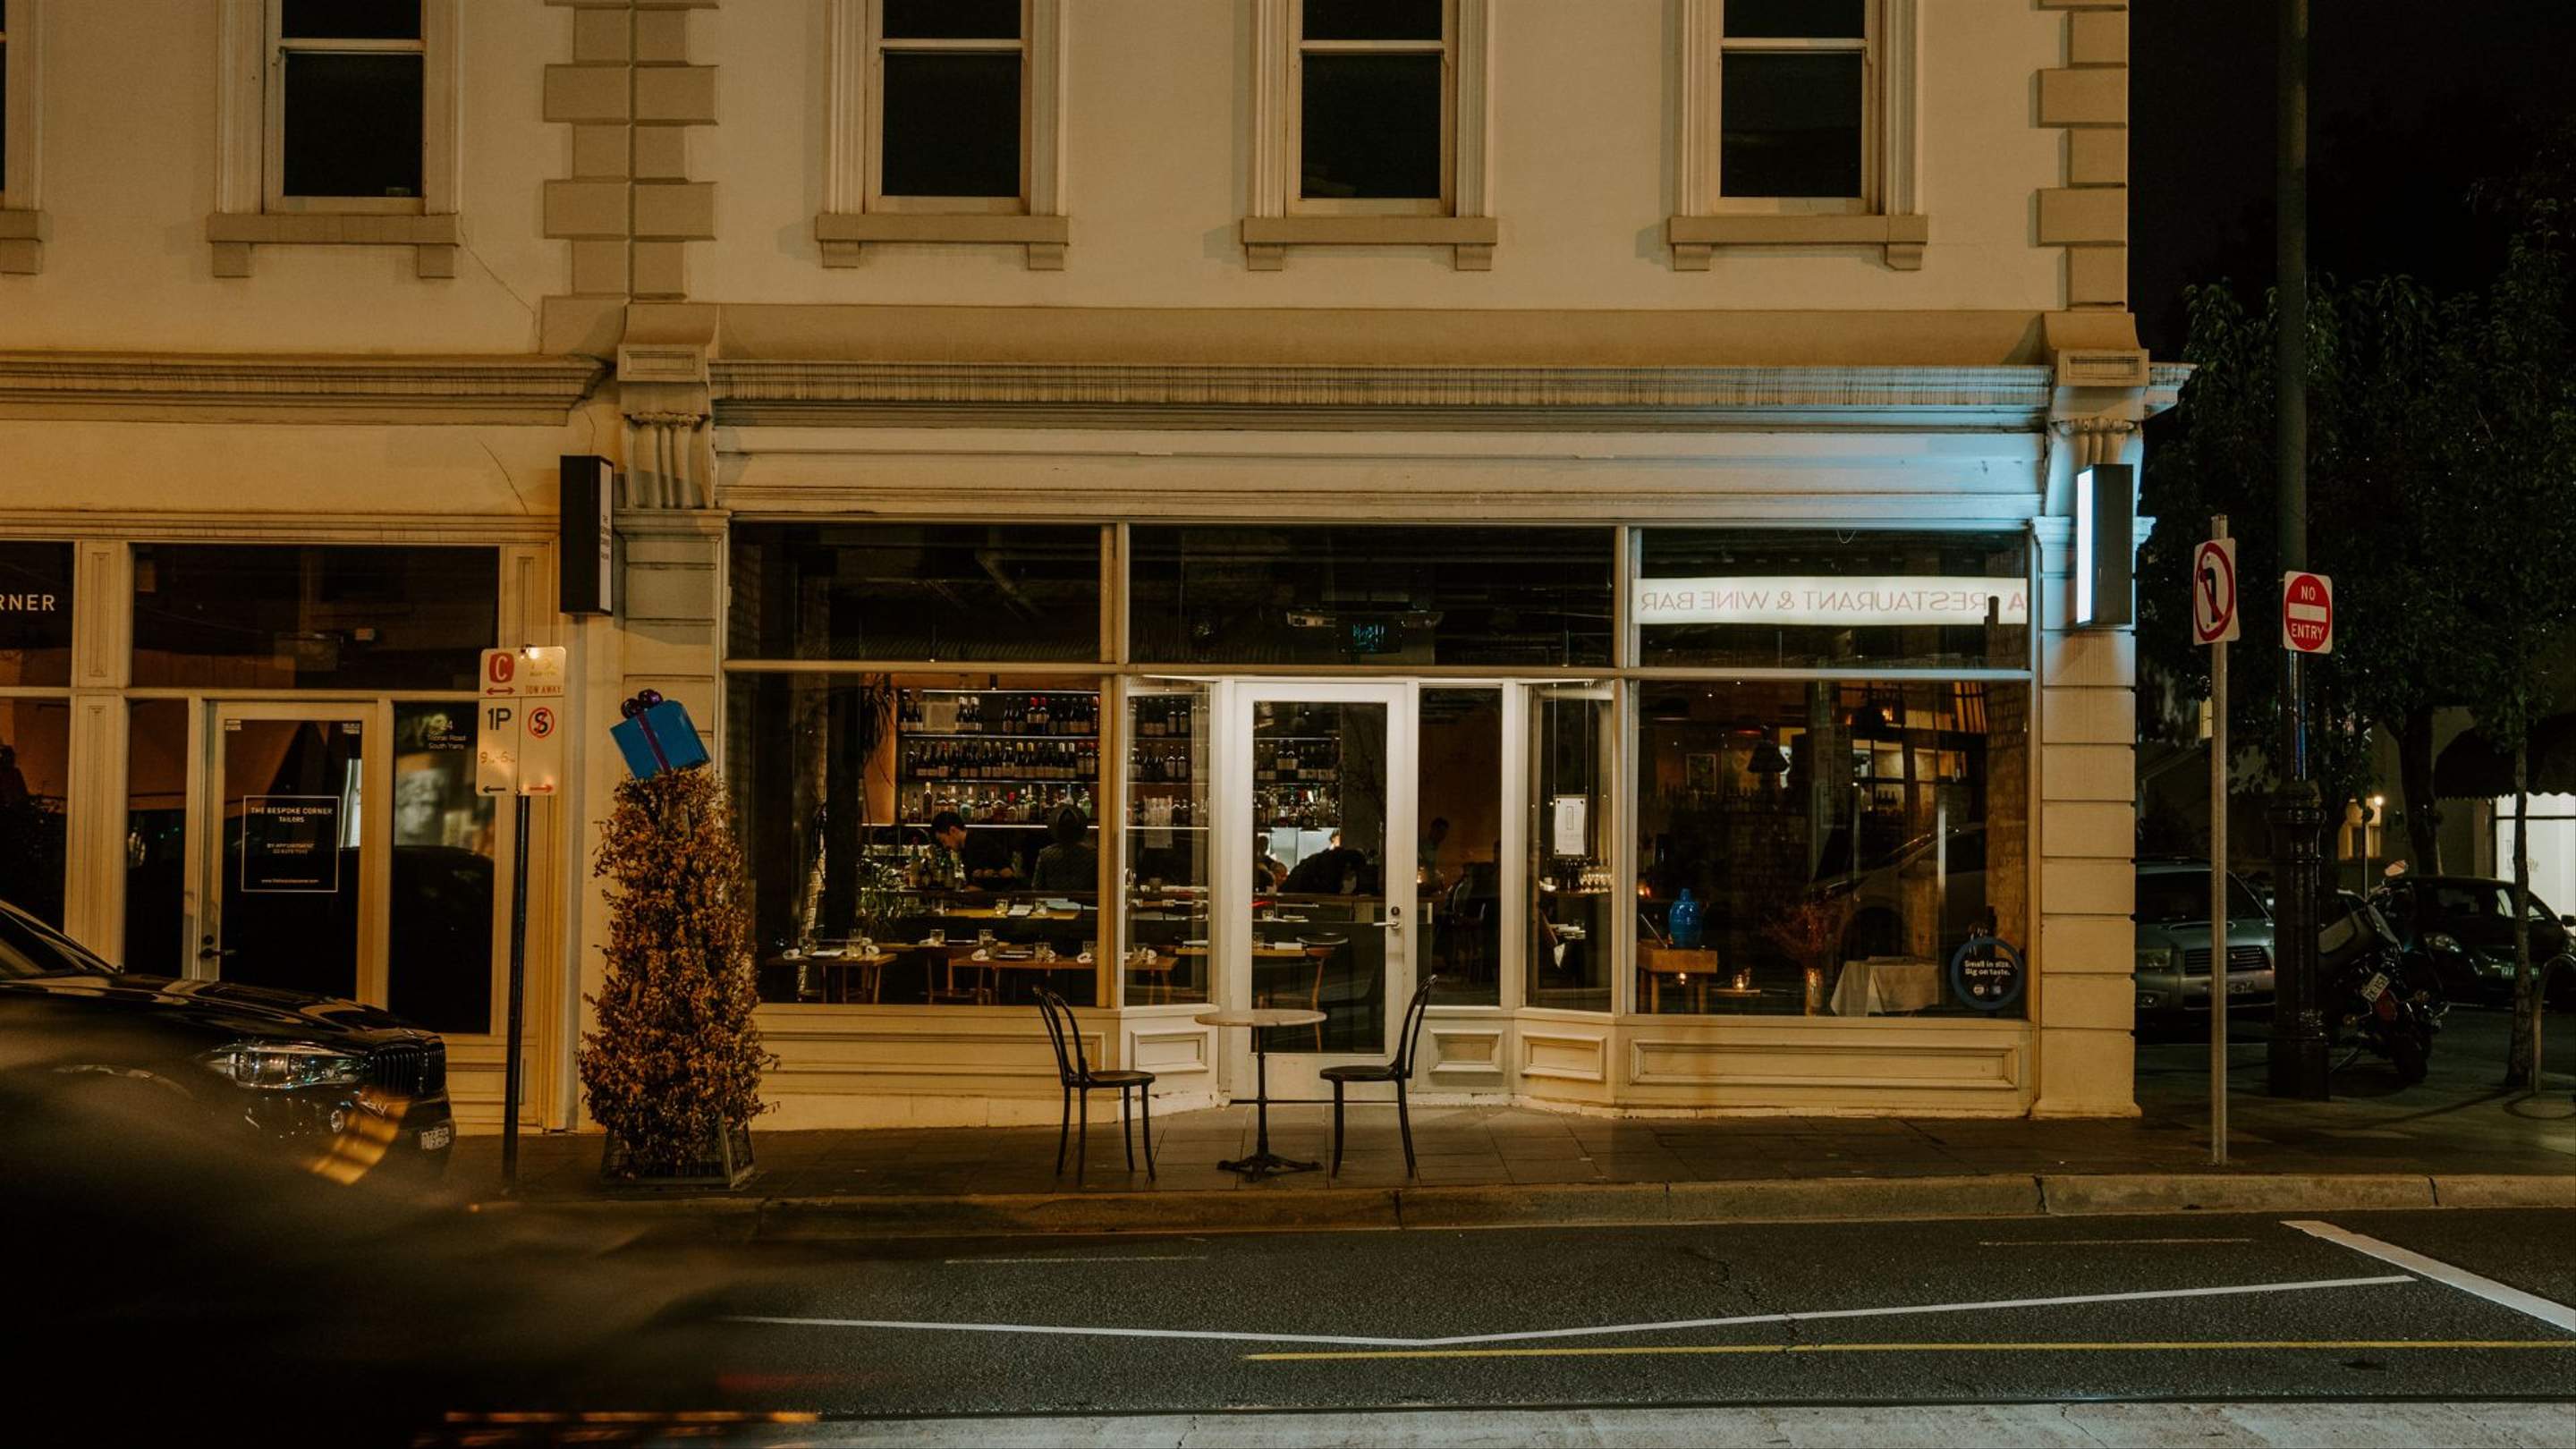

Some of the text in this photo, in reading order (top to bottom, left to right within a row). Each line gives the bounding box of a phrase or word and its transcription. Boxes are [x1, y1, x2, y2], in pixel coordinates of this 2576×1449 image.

[2301, 585, 2316, 601] NO
[2291, 623, 2325, 641] ENTRY
[541, 684, 562, 695] AWAY
[487, 708, 512, 731] 1P
[250, 807, 334, 815] THE BESPOKE CORNER
[279, 816, 305, 824] TAILORS
[1964, 960, 1985, 968] Small
[1987, 960, 1994, 968] in
[1964, 968, 1978, 977] Big
